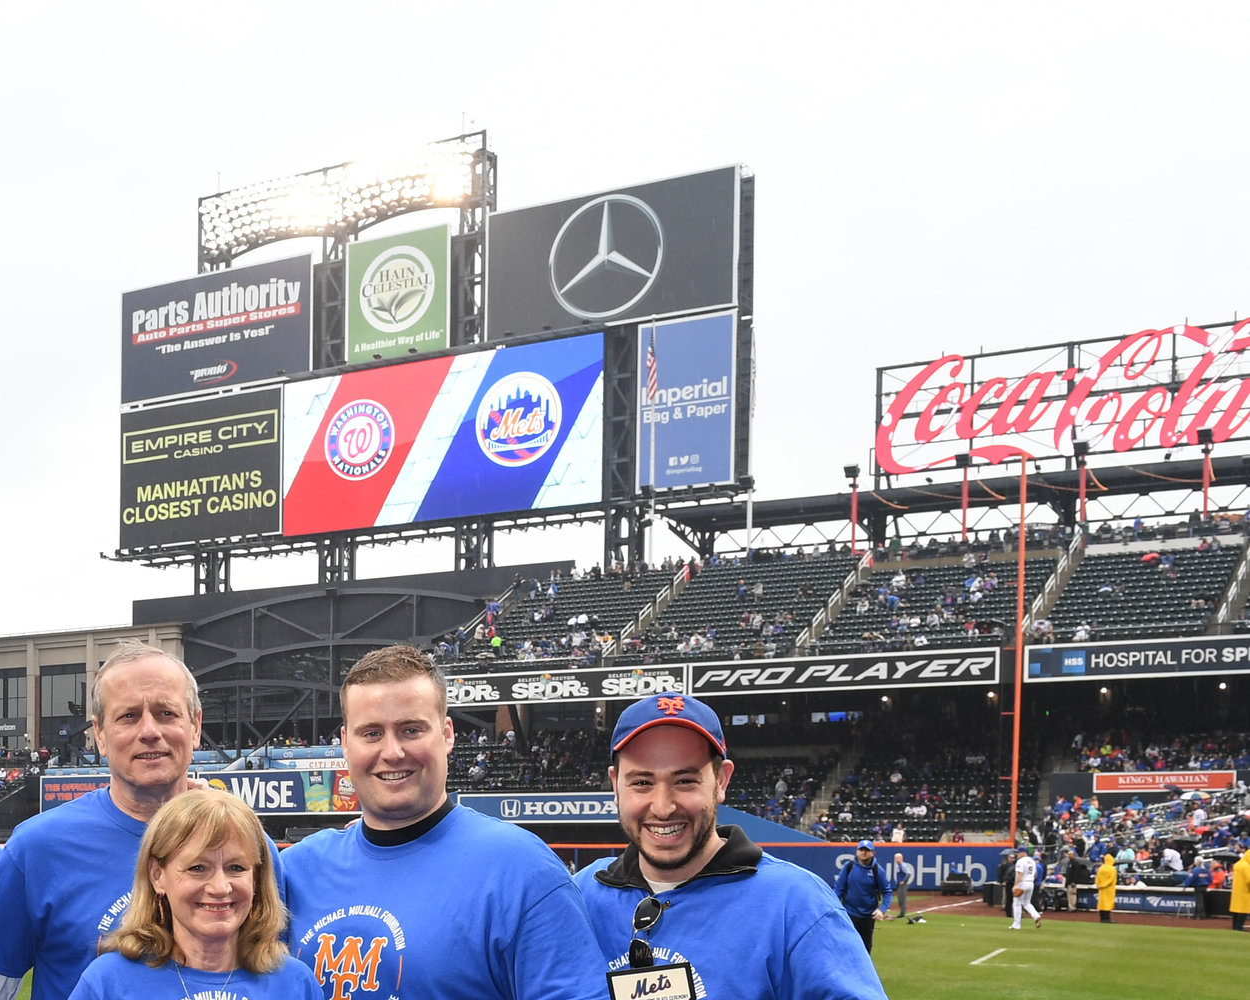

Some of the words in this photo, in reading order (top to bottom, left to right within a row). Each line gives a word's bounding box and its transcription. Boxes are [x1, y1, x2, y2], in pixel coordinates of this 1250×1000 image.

[362, 273, 432, 298] CELESTIAL
[379, 265, 415, 282] HAIN
[132, 300, 189, 334] Parts
[193, 278, 301, 322] Authority
[137, 331, 167, 343] Auto
[169, 322, 204, 336] Parts
[206, 311, 247, 328] Super
[249, 306, 296, 321] Stores
[183, 335, 228, 350] Answer
[230, 331, 241, 341] Is
[354, 344, 360, 353] A
[361, 338, 396, 351] Healthier
[398, 336, 414, 346] Way
[415, 333, 424, 342] of
[425, 329, 440, 340] Life
[330, 404, 389, 436] WASHINGTON
[490, 407, 545, 441] Mets
[643, 411, 669, 424] Bag
[673, 407, 683, 419] &
[687, 403, 728, 418] Paper
[132, 430, 212, 453] EMPIRE
[218, 421, 268, 440] CITY
[343, 422, 373, 458] W
[173, 445, 223, 459] CASINO
[332, 448, 387, 476] NATIONALS
[137, 470, 262, 503] MANHATTAN'S
[123, 499, 202, 525] CLOSEST
[207, 489, 276, 514] CASINO
[1064, 657, 1083, 666] HSS
[1091, 650, 1177, 668] HOSPITAL
[1181, 648, 1217, 664] FOR
[694, 666, 795, 688] PRO
[795, 656, 994, 685] PLAYER
[511, 679, 590, 700] SPDRs
[309, 761, 326, 769] CITI
[1118, 774, 1153, 785] KING'S
[1155, 774, 1209, 785] HAWAIIAN
[523, 801, 618, 816] HONDA
[98, 914, 113, 931] THE
[300, 928, 315, 946] THE
[313, 908, 347, 932] MICHAEL
[348, 904, 383, 918] MULHALL
[380, 909, 406, 951] FOUNDATION
[630, 974, 672, 1000] Mets
